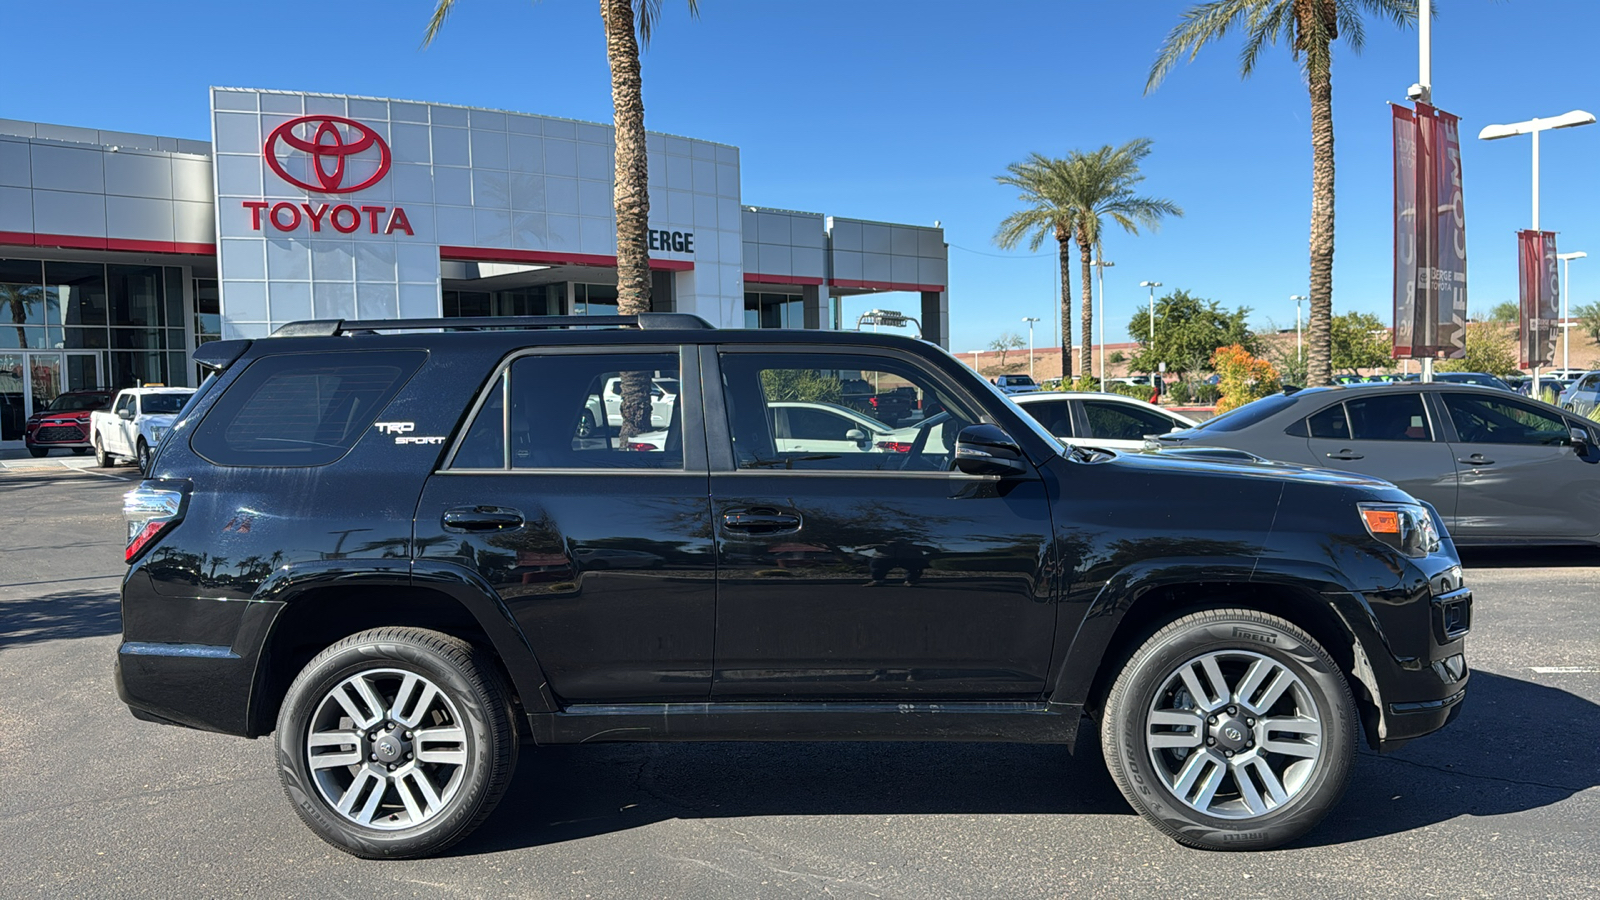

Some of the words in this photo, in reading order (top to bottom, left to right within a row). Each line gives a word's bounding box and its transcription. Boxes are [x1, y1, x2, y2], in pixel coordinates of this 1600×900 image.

[242, 201, 414, 236] TOYOTA
[648, 229, 694, 253] ERGE
[1431, 267, 1452, 281] BERGE
[1431, 281, 1452, 291] TOYOTA
[374, 422, 415, 434] TRD
[395, 436, 446, 445] SPORT
[1232, 626, 1278, 645] PIRELLI
